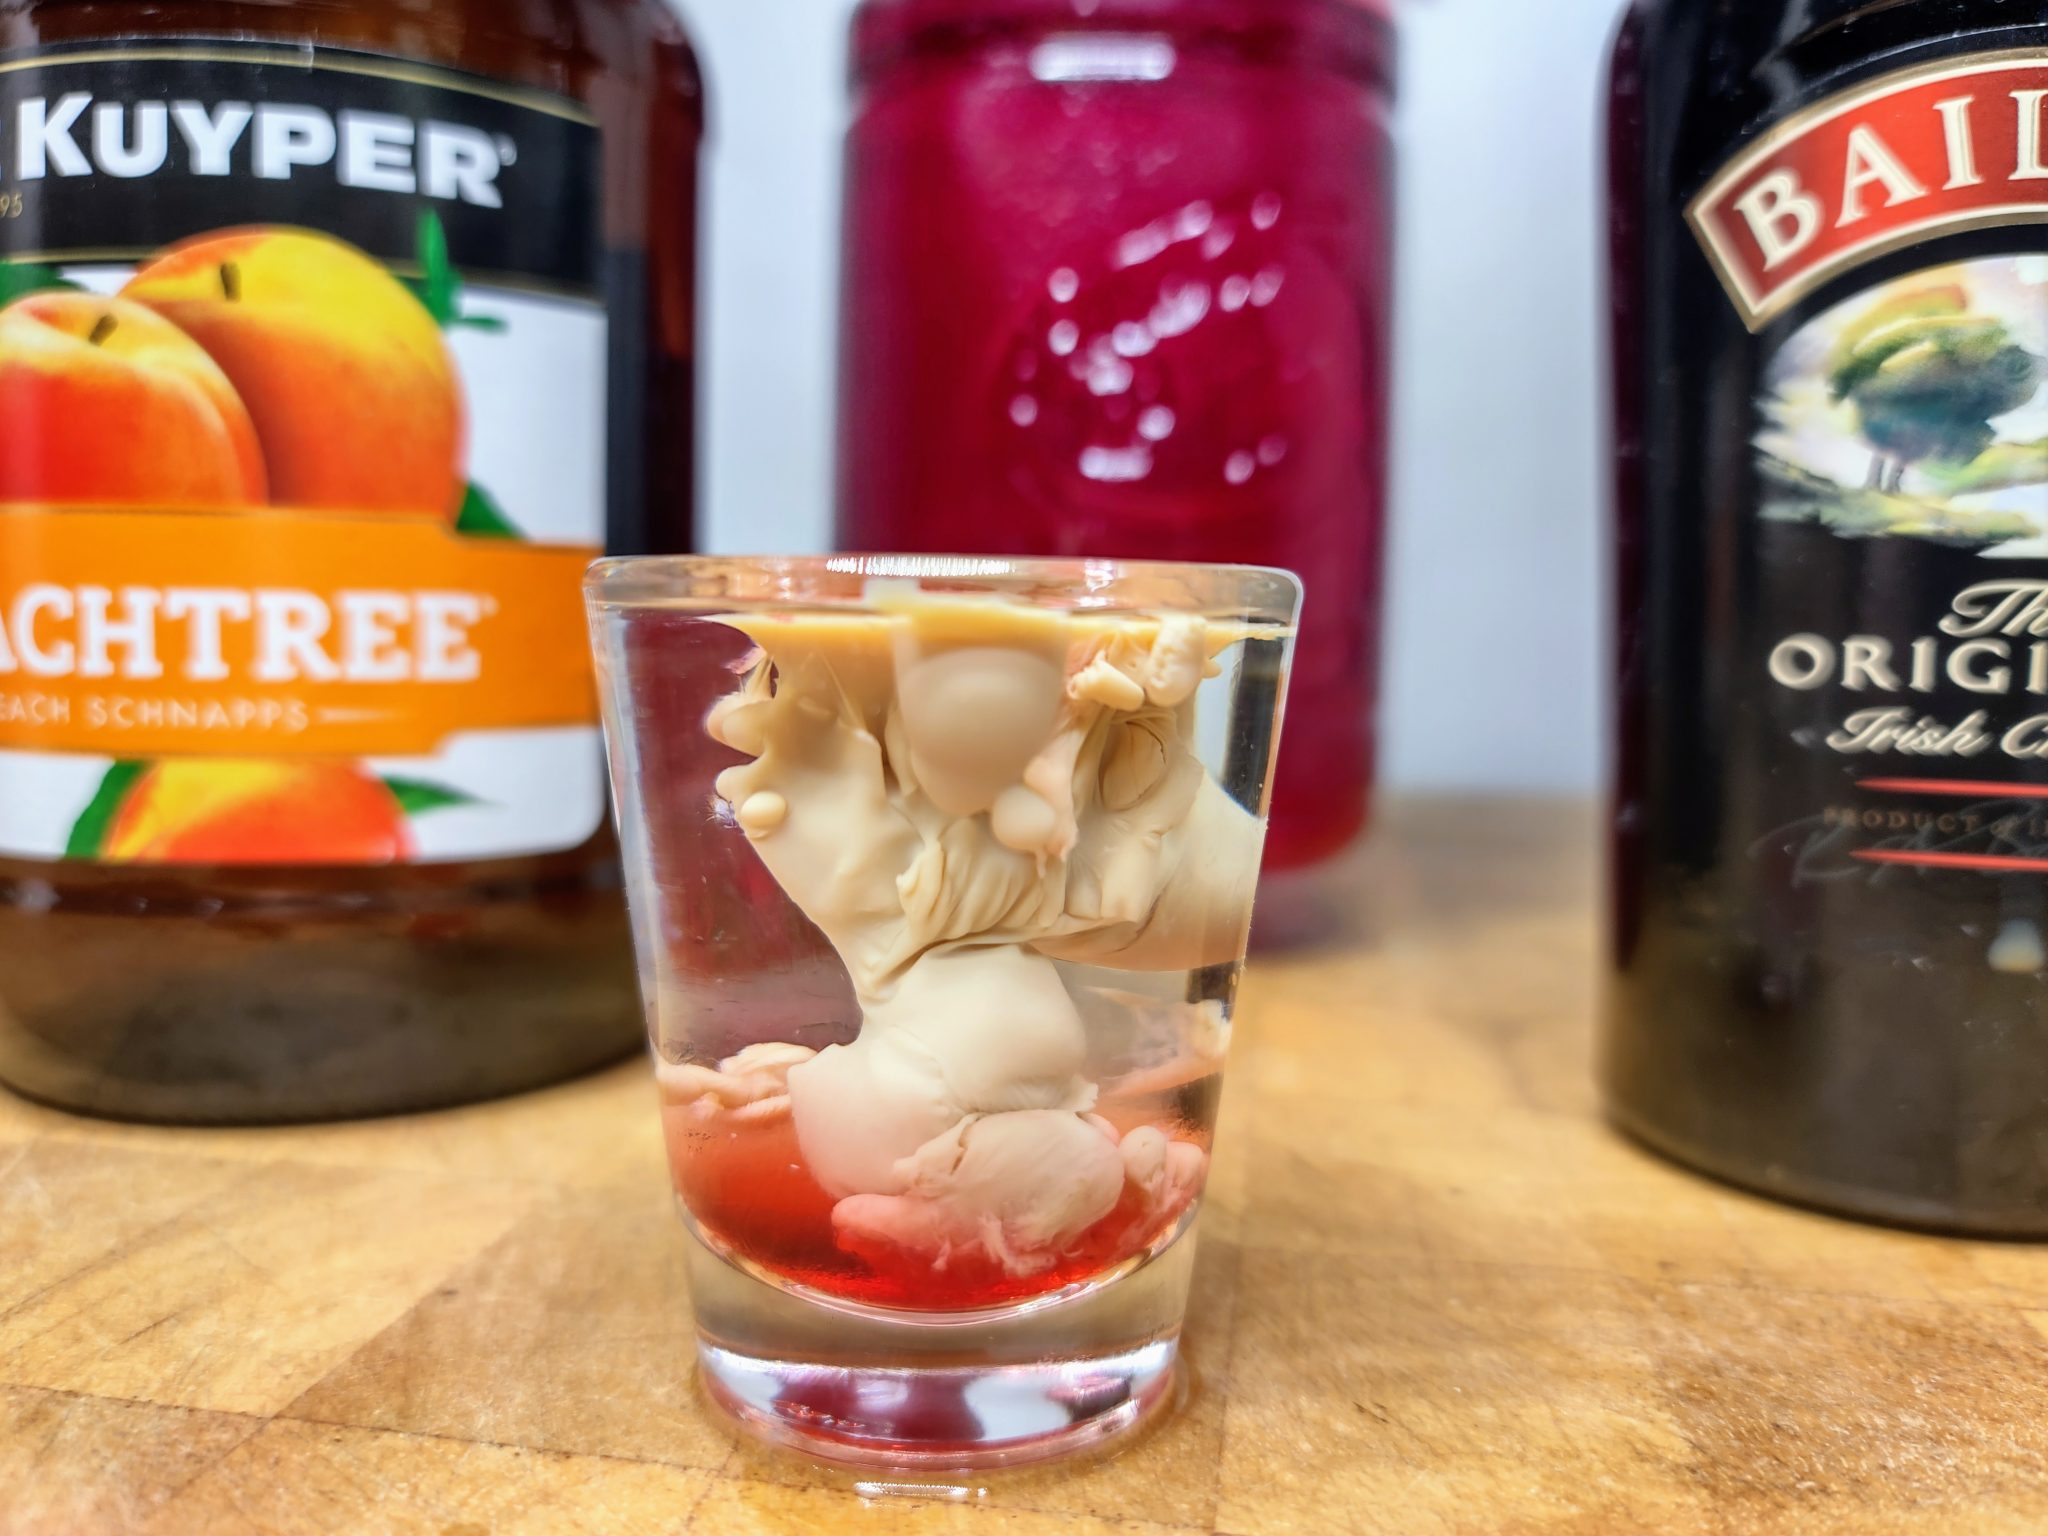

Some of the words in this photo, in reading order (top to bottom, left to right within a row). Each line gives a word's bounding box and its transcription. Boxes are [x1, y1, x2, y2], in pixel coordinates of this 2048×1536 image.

[16, 91, 503, 208] KUYPER
[0, 584, 482, 682] CHTREE
[88, 694, 309, 733] SCHNAPPS
[1826, 706, 1994, 757] Irish
[1823, 805, 1980, 834] PRODUCT
